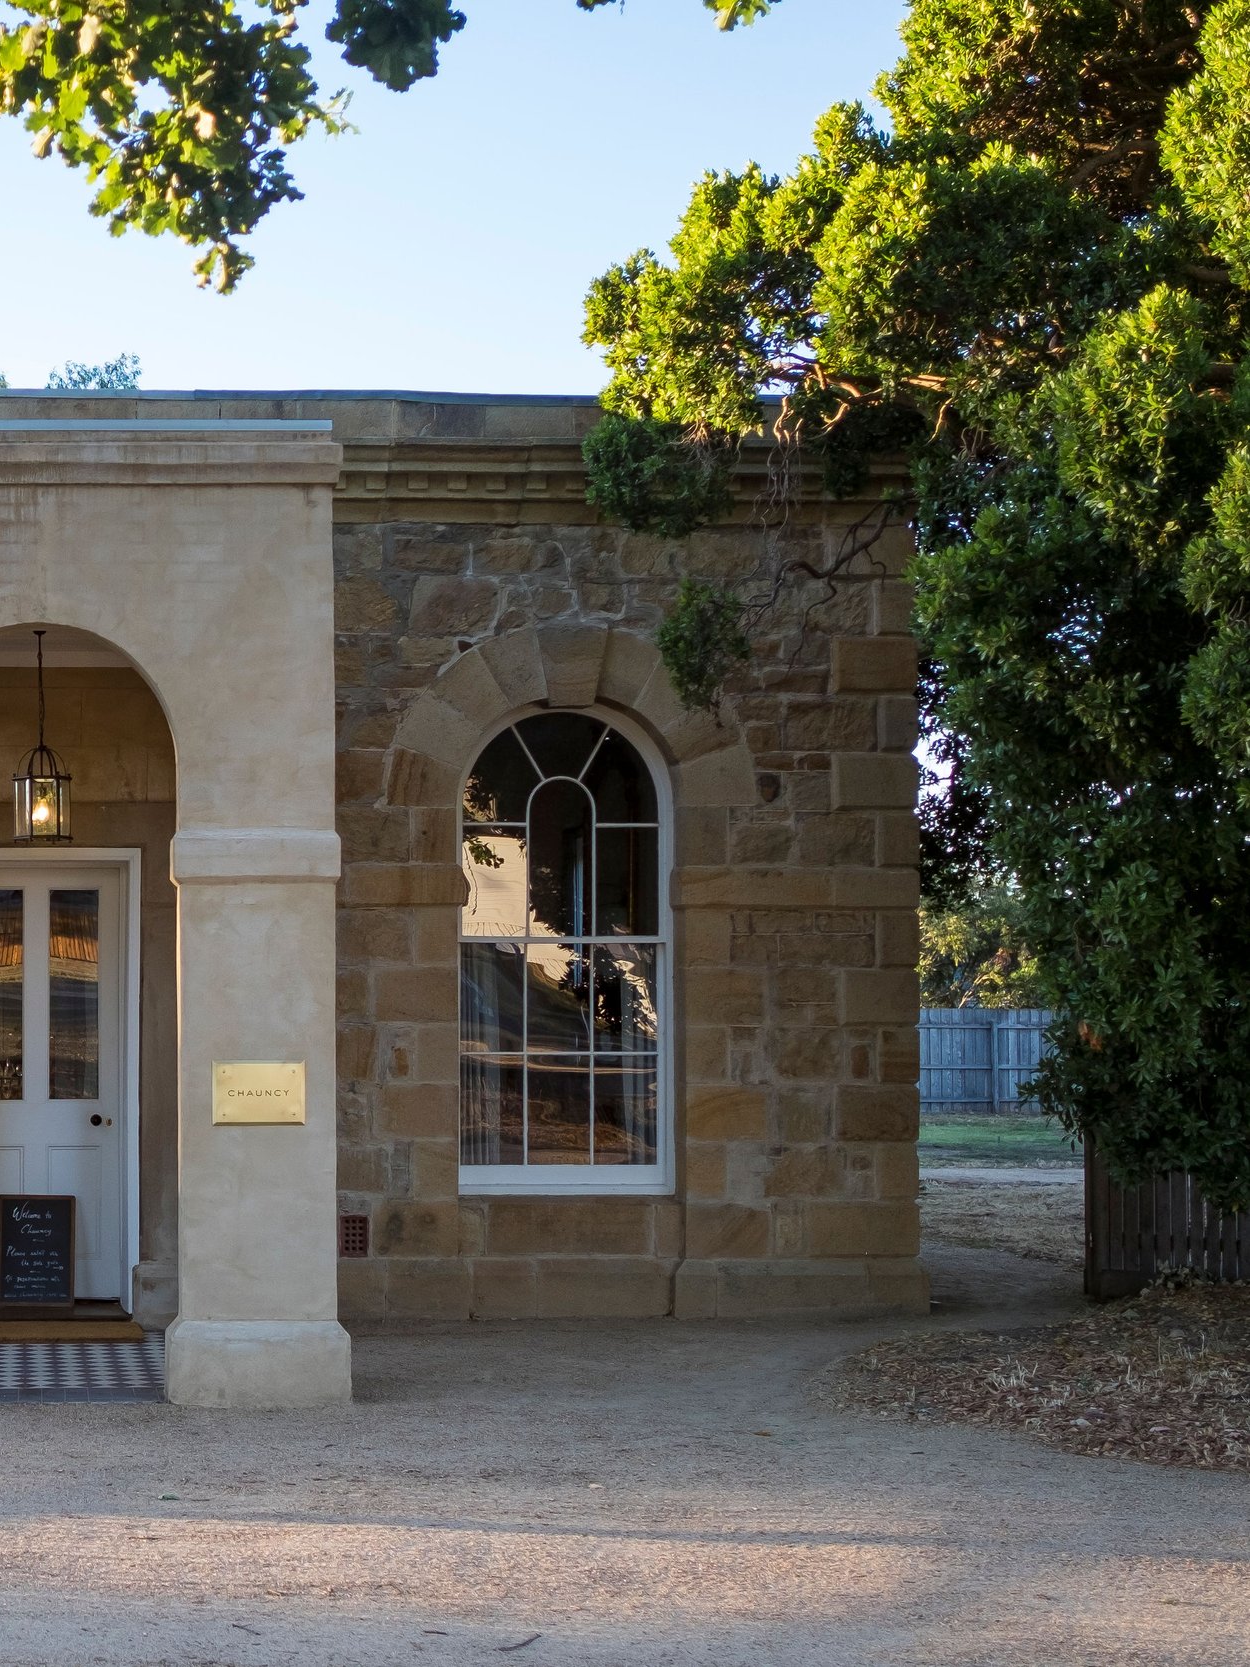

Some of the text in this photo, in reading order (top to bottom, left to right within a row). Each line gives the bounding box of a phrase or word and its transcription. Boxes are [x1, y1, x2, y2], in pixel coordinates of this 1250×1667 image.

[227, 1089, 290, 1097] CHAUNCY
[12, 1200, 52, 1221] Welcome to
[20, 1223, 52, 1237] Chauncy
[6, 1245, 26, 1257] Please
